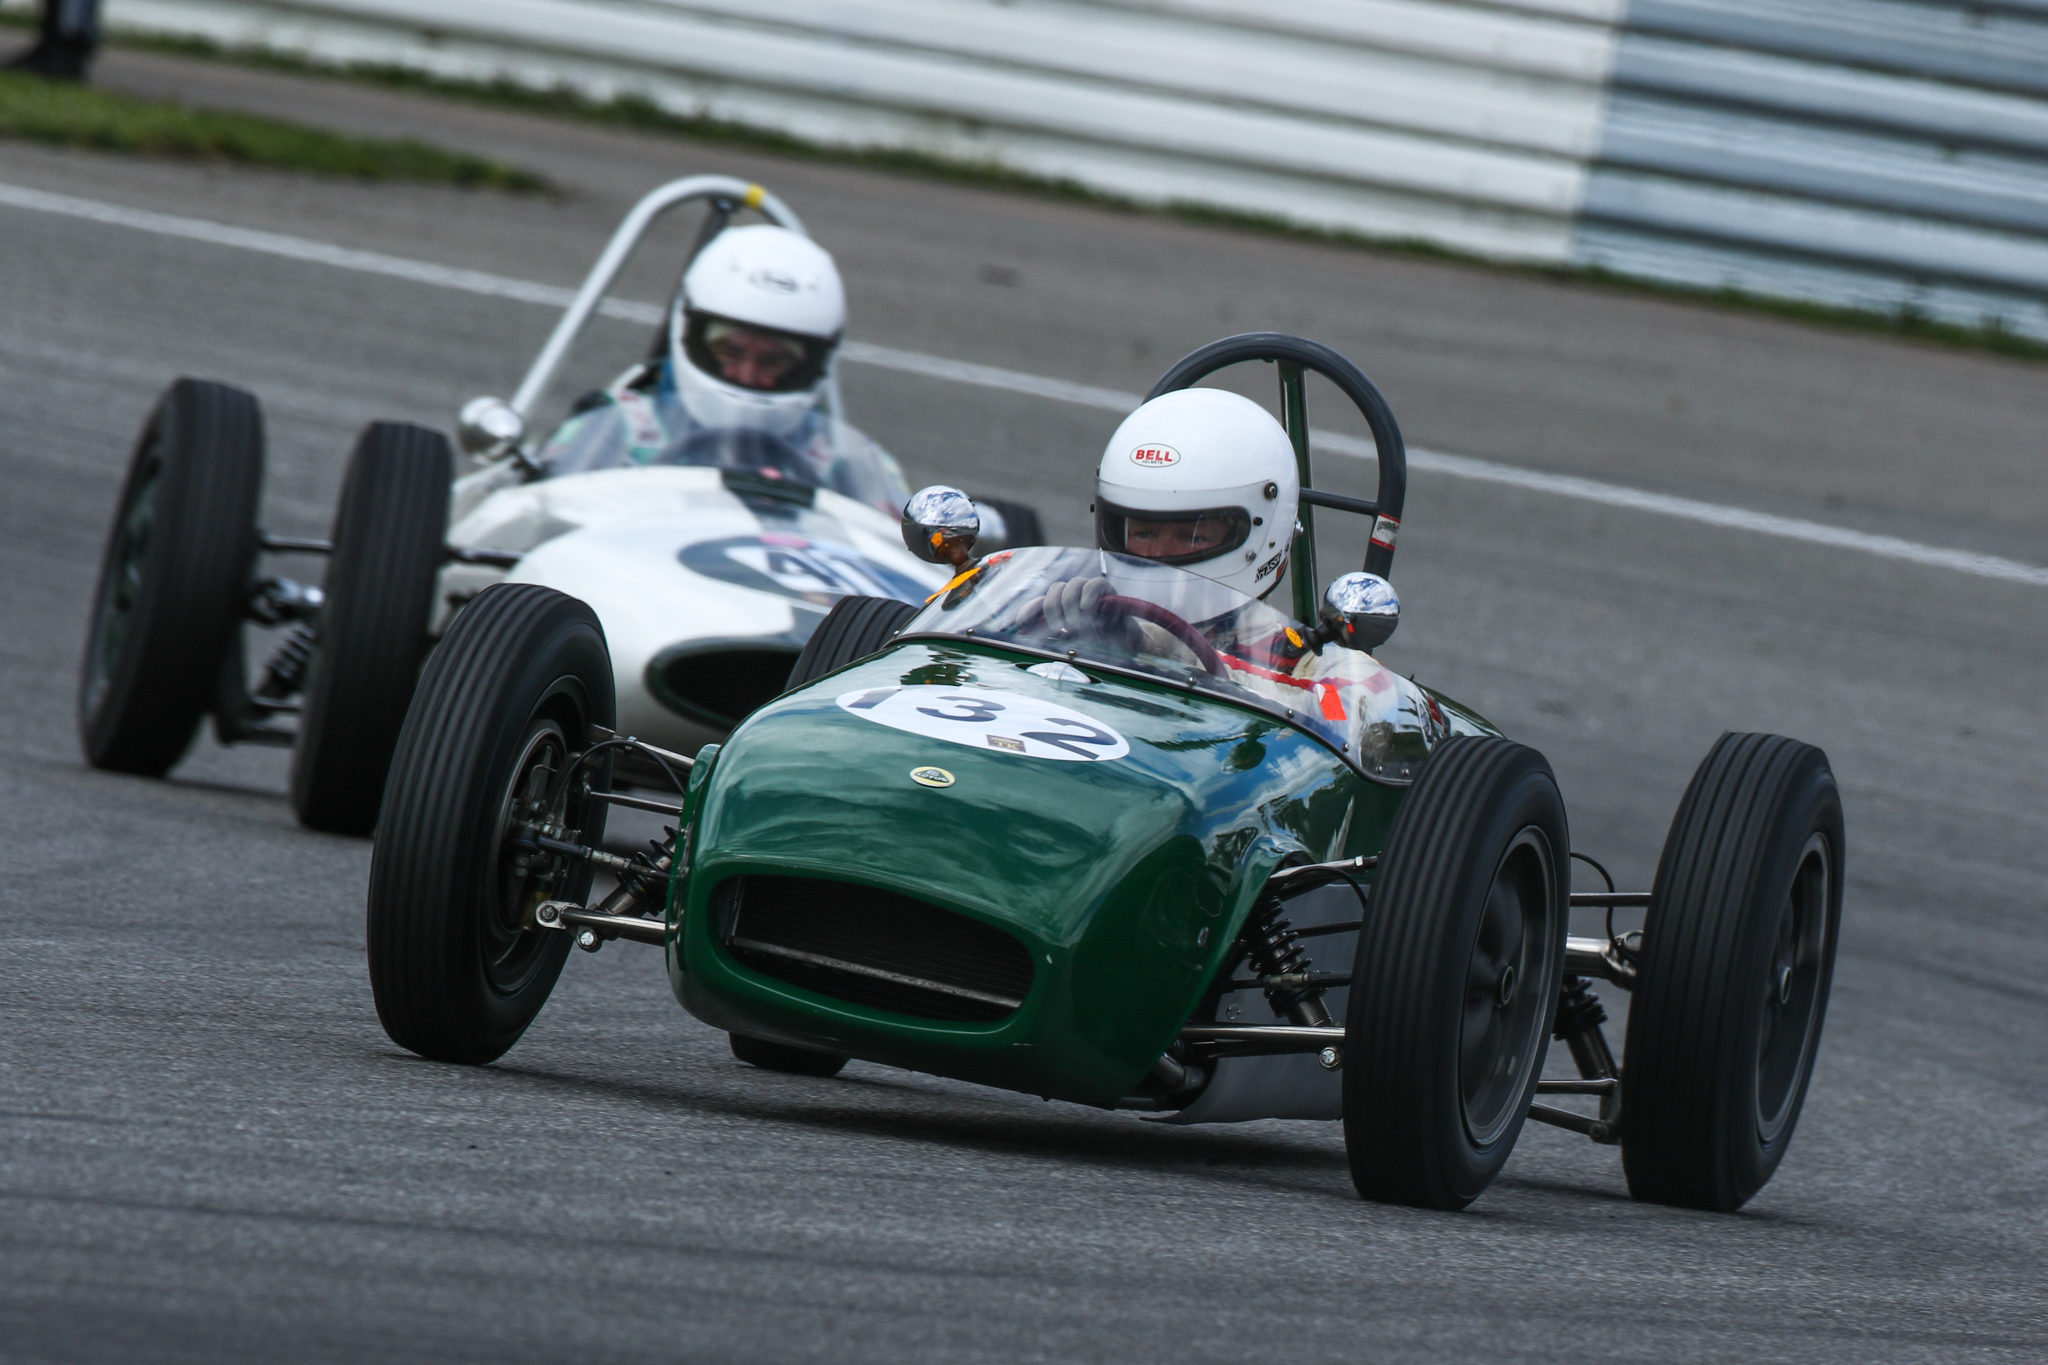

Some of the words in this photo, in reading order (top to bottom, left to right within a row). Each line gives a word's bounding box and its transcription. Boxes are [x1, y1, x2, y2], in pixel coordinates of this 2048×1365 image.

[1135, 449, 1173, 462] BELL
[848, 688, 1117, 760] 132
[915, 772, 948, 782] LOTUS
